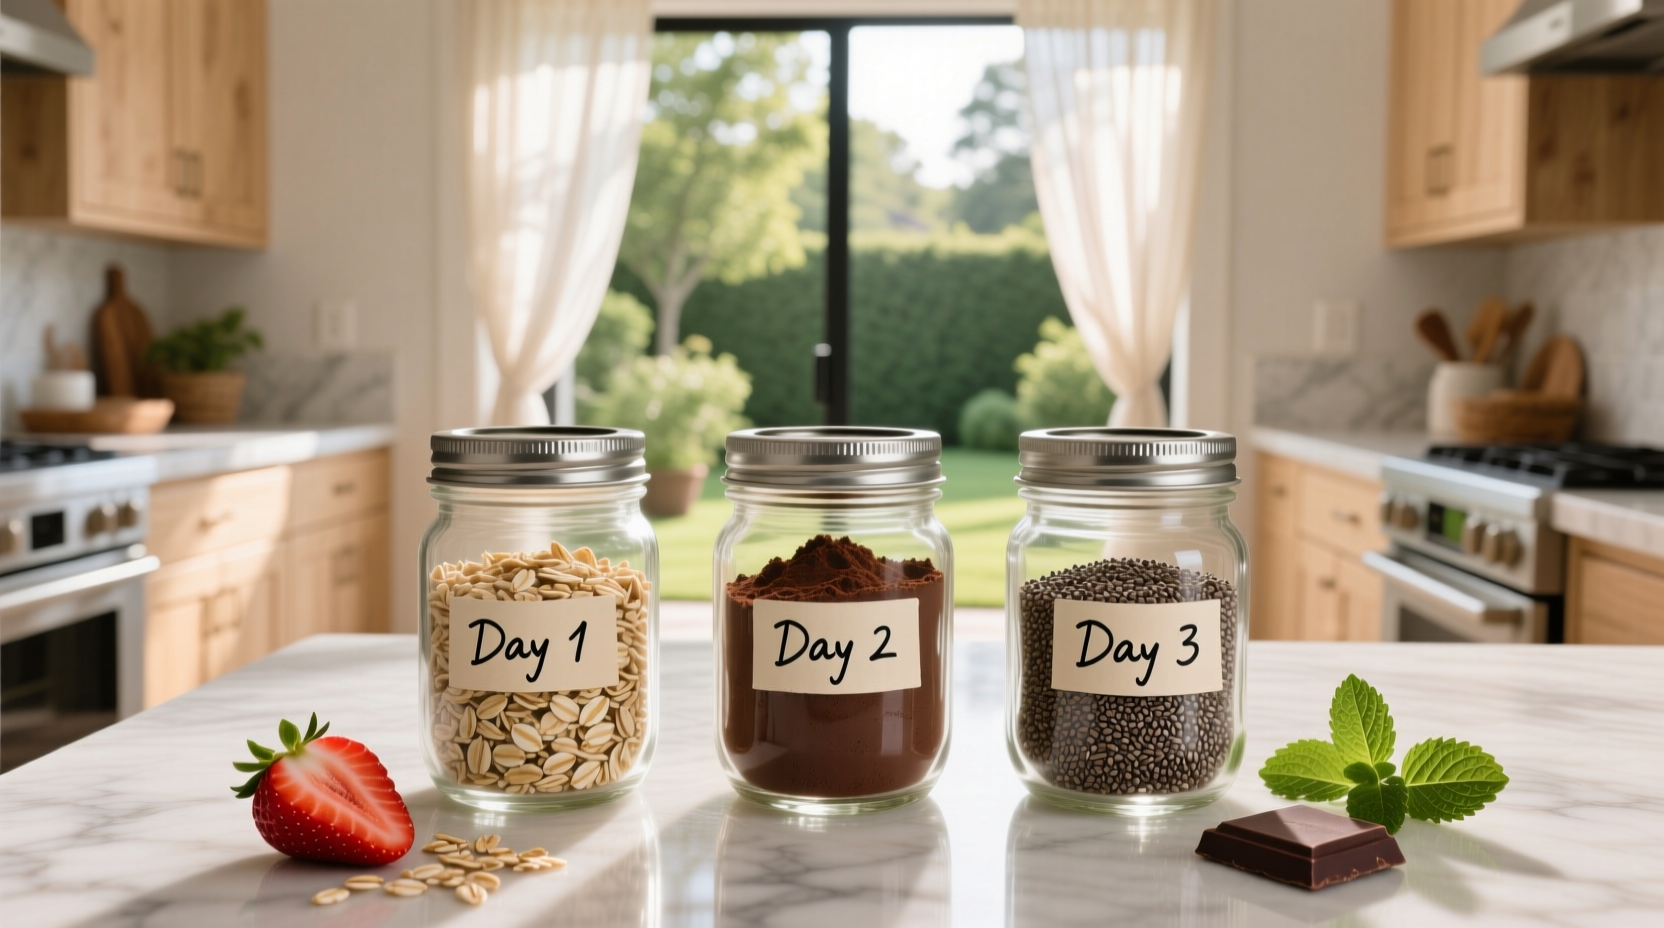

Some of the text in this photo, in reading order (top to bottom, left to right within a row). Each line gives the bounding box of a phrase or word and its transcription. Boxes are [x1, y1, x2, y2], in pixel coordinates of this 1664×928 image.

[468, 618, 588, 683] Day 1
[773, 619, 897, 686] Day 2
[1075, 619, 1200, 687] Day 3
